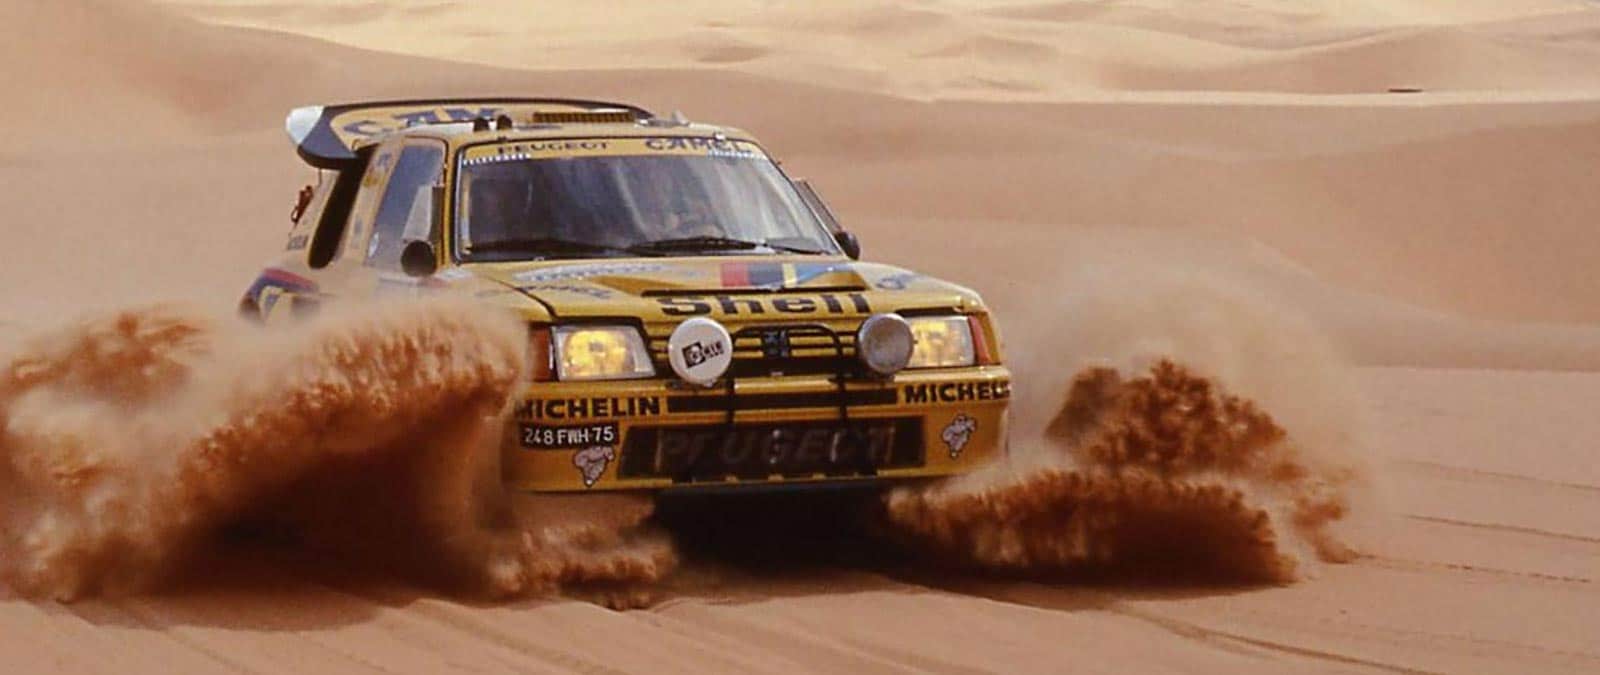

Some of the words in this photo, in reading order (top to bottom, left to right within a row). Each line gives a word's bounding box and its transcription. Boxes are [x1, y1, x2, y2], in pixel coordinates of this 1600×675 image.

[656, 293, 871, 316] Shell
[904, 381, 1009, 403] MICHEL
[514, 397, 660, 419] MICHELIN
